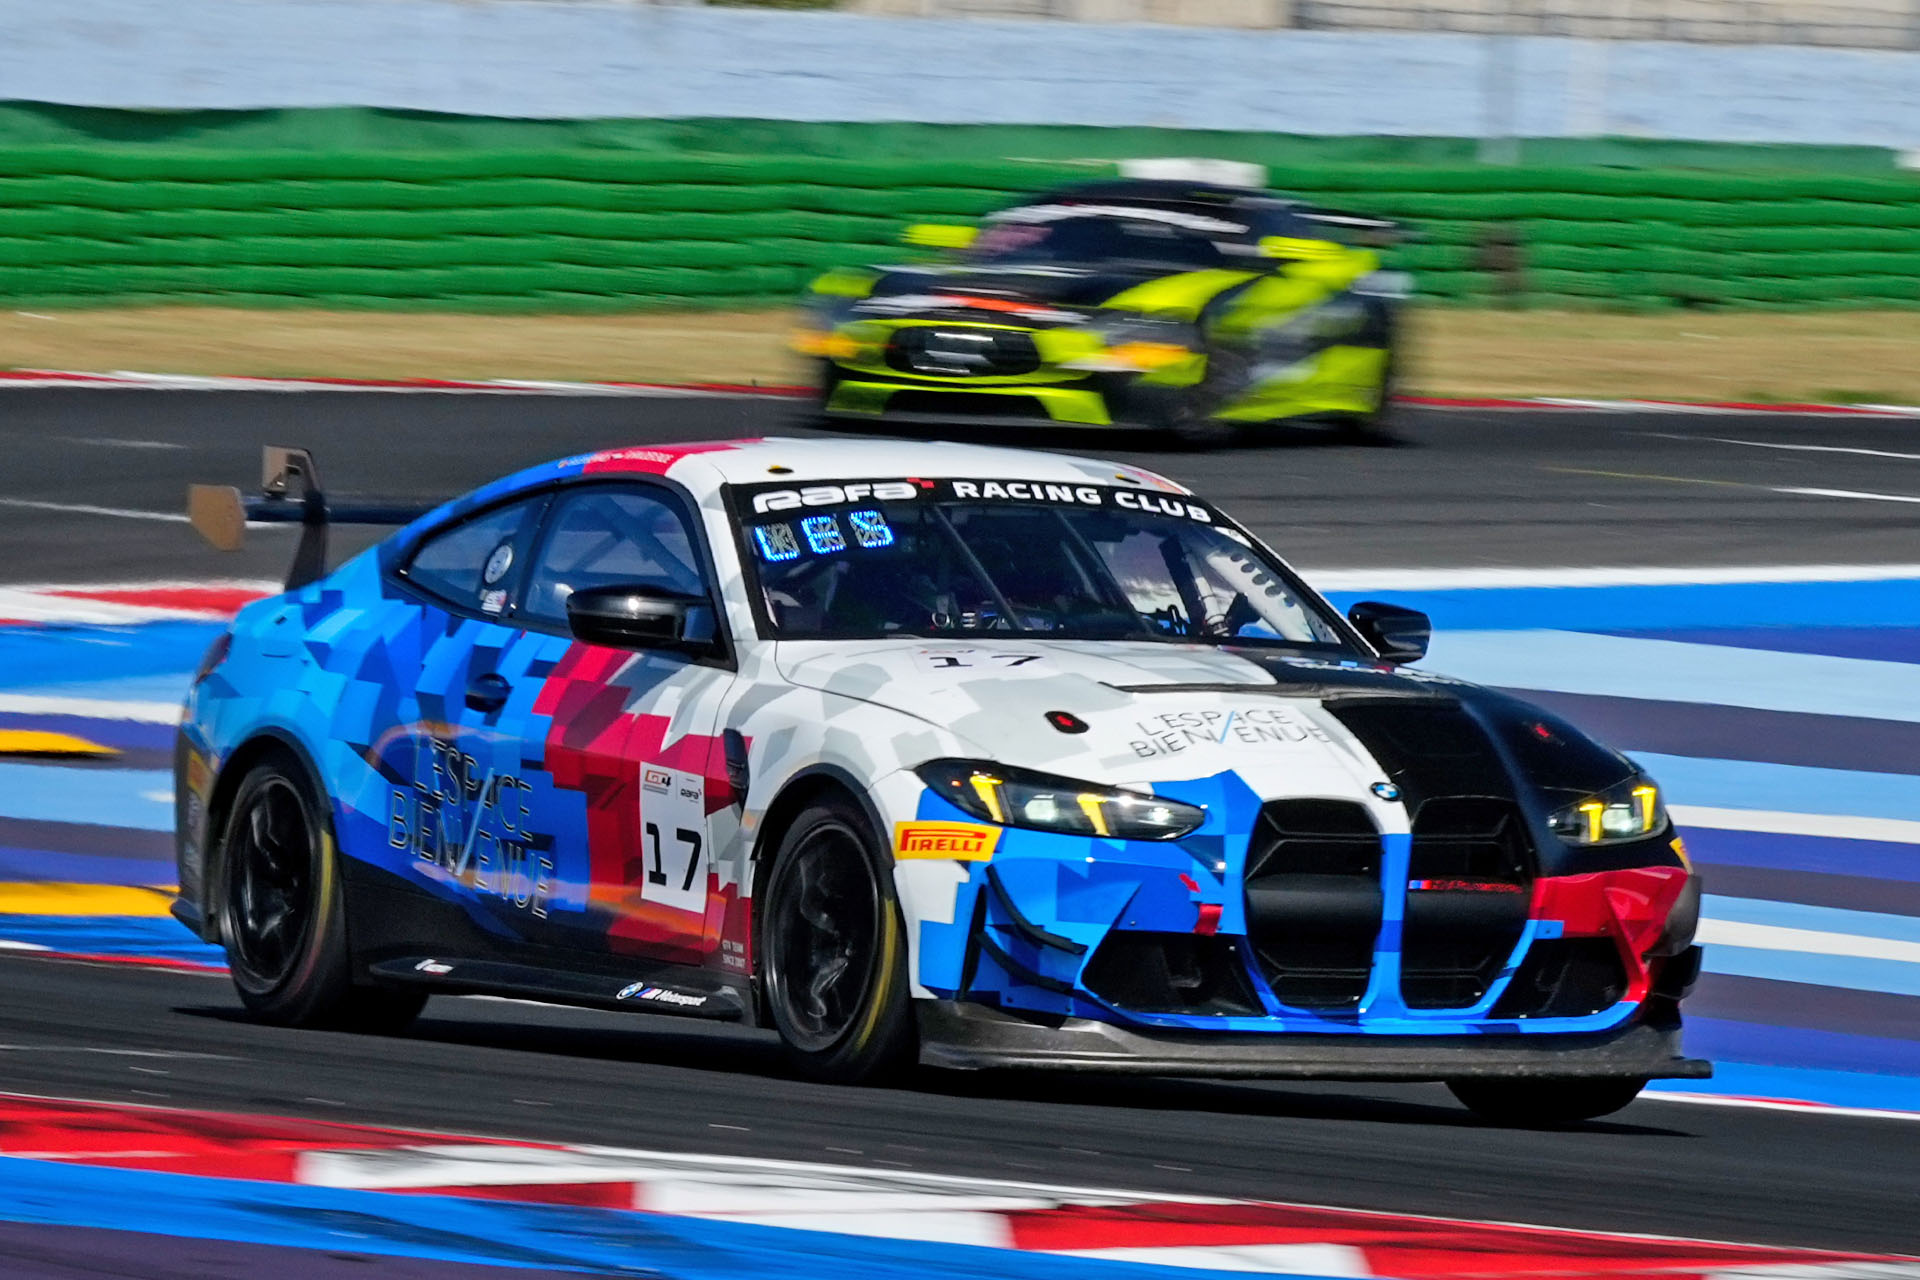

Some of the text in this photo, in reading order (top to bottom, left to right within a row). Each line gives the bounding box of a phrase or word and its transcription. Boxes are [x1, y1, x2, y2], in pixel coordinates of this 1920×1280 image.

[952, 481, 1102, 505] RACING
[1115, 491, 1212, 523] CLUB
[928, 655, 1044, 668] 17
[645, 821, 703, 892] 17
[900, 829, 987, 852] PIRELLI
